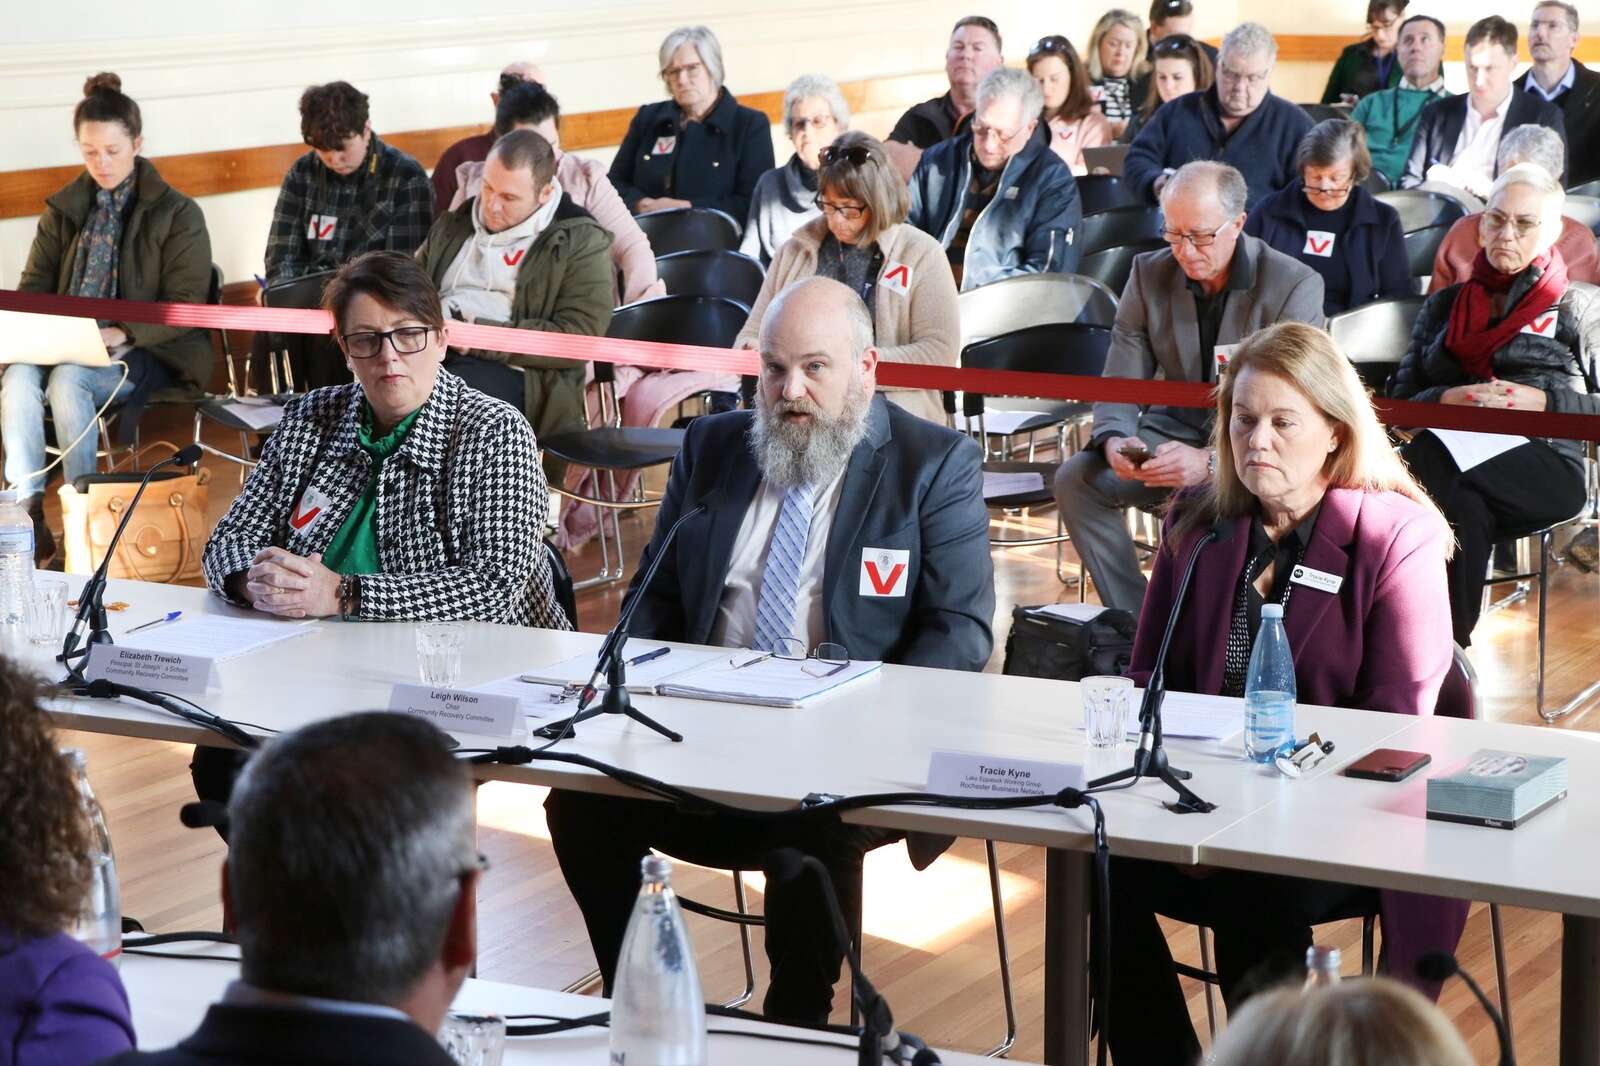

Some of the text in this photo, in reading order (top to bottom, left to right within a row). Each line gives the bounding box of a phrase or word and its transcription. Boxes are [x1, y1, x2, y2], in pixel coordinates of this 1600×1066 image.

[1309, 238, 1330, 254] V
[503, 250, 525, 266] V
[864, 560, 906, 595] V
[120, 651, 182, 664] Elizabeth Trewich
[431, 692, 478, 703] Leigh Wilson
[980, 766, 1031, 779] Tracie Kyne
